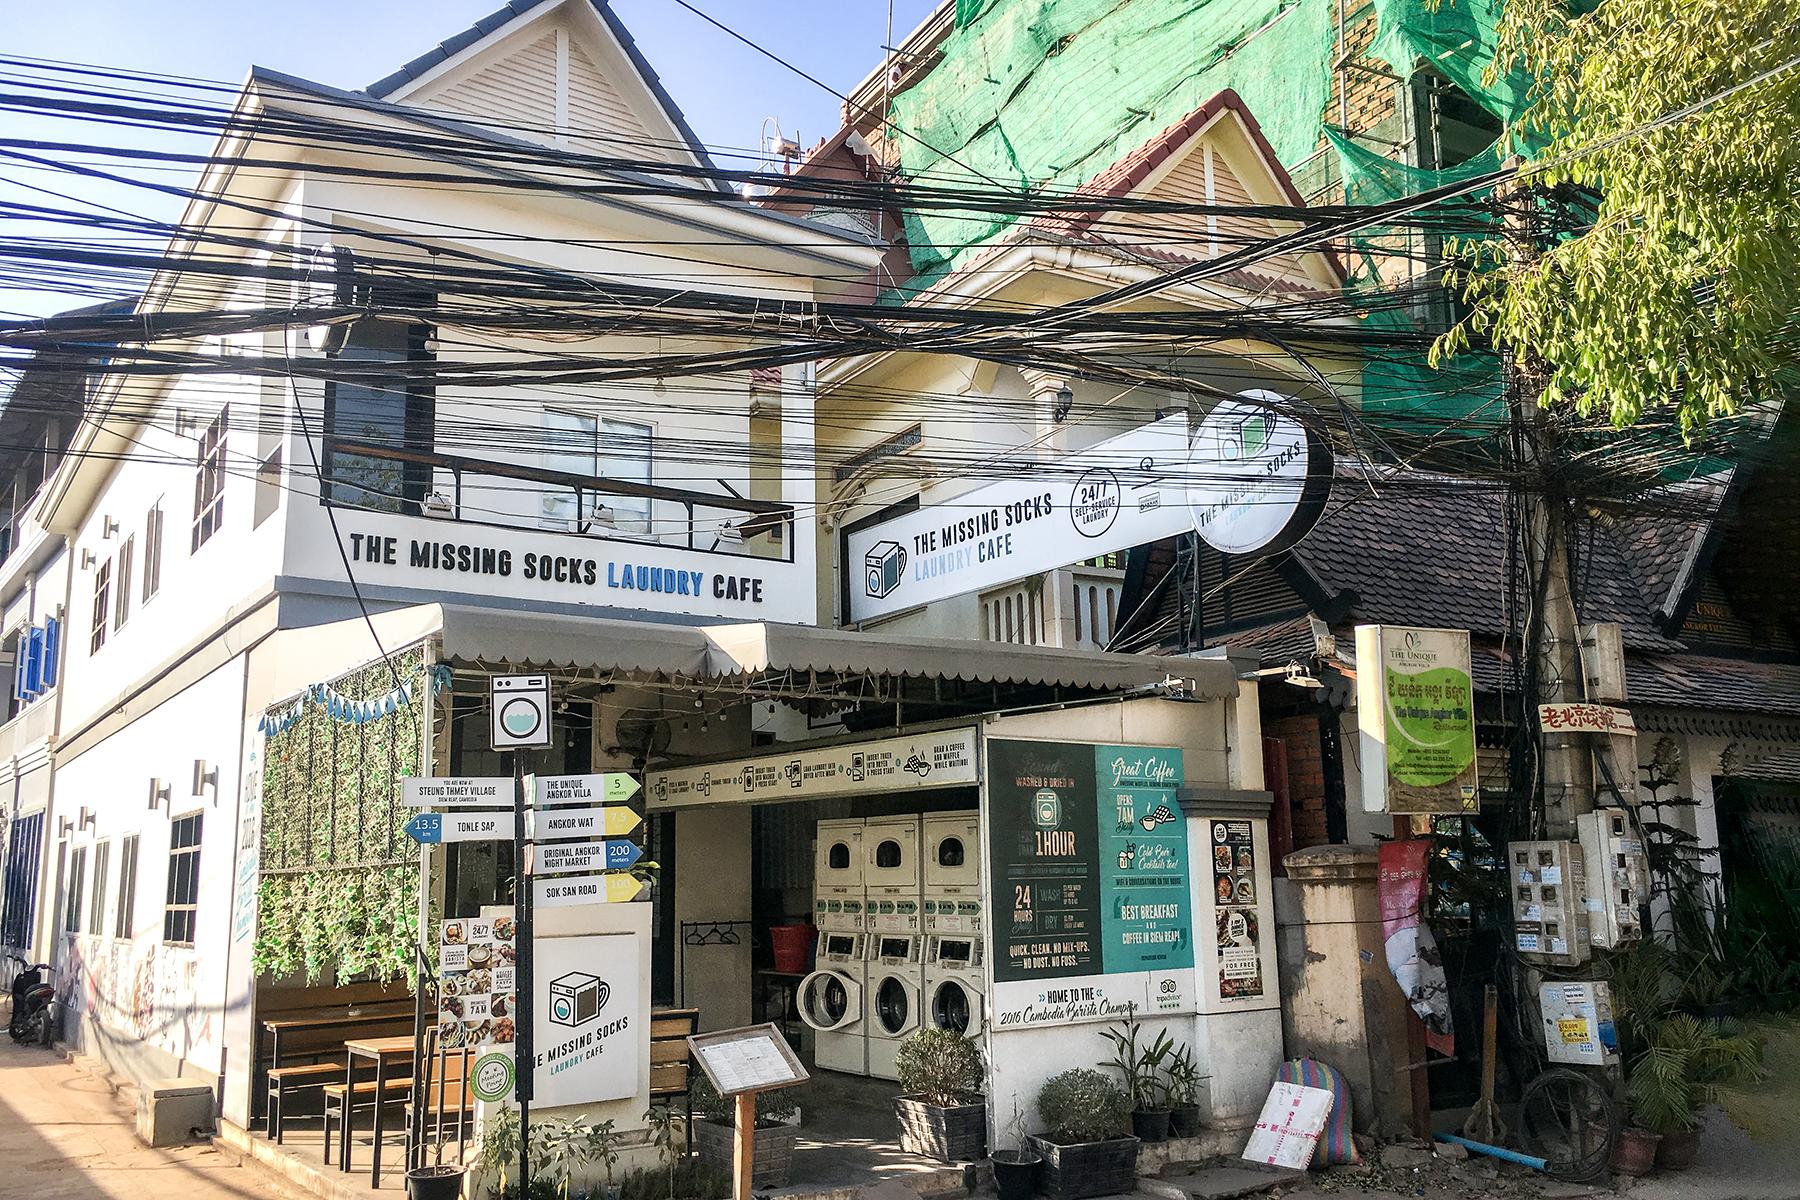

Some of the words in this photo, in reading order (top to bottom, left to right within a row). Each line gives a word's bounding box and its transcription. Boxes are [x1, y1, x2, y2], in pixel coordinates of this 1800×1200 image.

[1200, 504, 1217, 527] THE
[1267, 441, 1300, 476] SOCKS
[1075, 496, 1115, 518] SELF-SERVICE
[1083, 508, 1109, 525] LAUNDRY
[914, 531, 936, 556] THE
[942, 509, 998, 548] MISSING
[1005, 492, 1052, 526] SOCKS
[915, 546, 972, 581] LAUNDRY
[978, 532, 1012, 563] CAFE
[350, 533, 397, 565] THE
[410, 540, 512, 576] MISSING
[523, 552, 597, 585] SOCKS
[607, 562, 704, 597] LAUNDRY
[712, 574, 763, 602] CAFE
[1391, 651, 1404, 659] THE
[1407, 651, 1438, 661] UNIQUE
[1111, 757, 1143, 787] Great
[1145, 756, 1175, 783] Coffee
[546, 781, 558, 789] THE
[560, 779, 583, 789] UNIQUE
[614, 779, 621, 789] 5
[1016, 777, 1042, 787] WASHED
[1049, 777, 1067, 788] DRIED
[419, 787, 444, 796] STEUNG
[446, 787, 469, 795] THMEY
[470, 786, 496, 795] VILLAGE
[547, 790, 572, 799] ANGKOR
[573, 789, 592, 798] VILLA
[1116, 794, 1133, 806] OPENS
[1116, 807, 1135, 823] 7AM
[415, 819, 439, 830] 13.5
[458, 822, 479, 832] TONLE
[548, 819, 576, 829] ANGKOR
[578, 818, 594, 828] WAT
[544, 848, 573, 859] ORIGINAL
[575, 846, 600, 856] ANGKOR
[610, 846, 630, 856] 200
[545, 859, 563, 868] NIGHT
[565, 857, 591, 867] MARKET
[546, 887, 560, 898] SOK
[562, 886, 577, 896] SAN
[578, 885, 597, 895] ROAD
[1015, 885, 1031, 909] 24
[1014, 910, 1032, 922] HOURS
[1121, 905, 1139, 920] BEST
[1140, 904, 1178, 919] BREAKFAST
[473, 925, 489, 935] 24/7
[1122, 932, 1142, 945] COFFEE
[1143, 932, 1150, 944] IN
[1151, 931, 1164, 943] SIEM
[1164, 930, 1180, 942] REAP!
[1009, 945, 1030, 958] QUICK.
[1031, 943, 1052, 955] CLEAN.
[1053, 942, 1062, 954] NO
[1062, 941, 1090, 953] MIX-UPS.
[1023, 958, 1032, 969] NO
[1033, 957, 1051, 968] DUST.
[1051, 956, 1060, 967] NO
[1060, 954, 1078, 967] FUSS.
[1047, 989, 1068, 1004] HOME
[1069, 988, 1079, 1003] TO
[1080, 987, 1095, 1001] THE
[470, 1004, 487, 1015] 7AM
[1000, 1011, 1021, 1025] 2016
[1023, 1004, 1064, 1023] Cambodia
[1066, 1001, 1097, 1022] Barista
[548, 1032, 592, 1062] MISSING
[597, 1016, 628, 1041] SOCKS
[550, 1053, 584, 1075] LAUNDRY
[586, 1045, 603, 1060] CAFE
